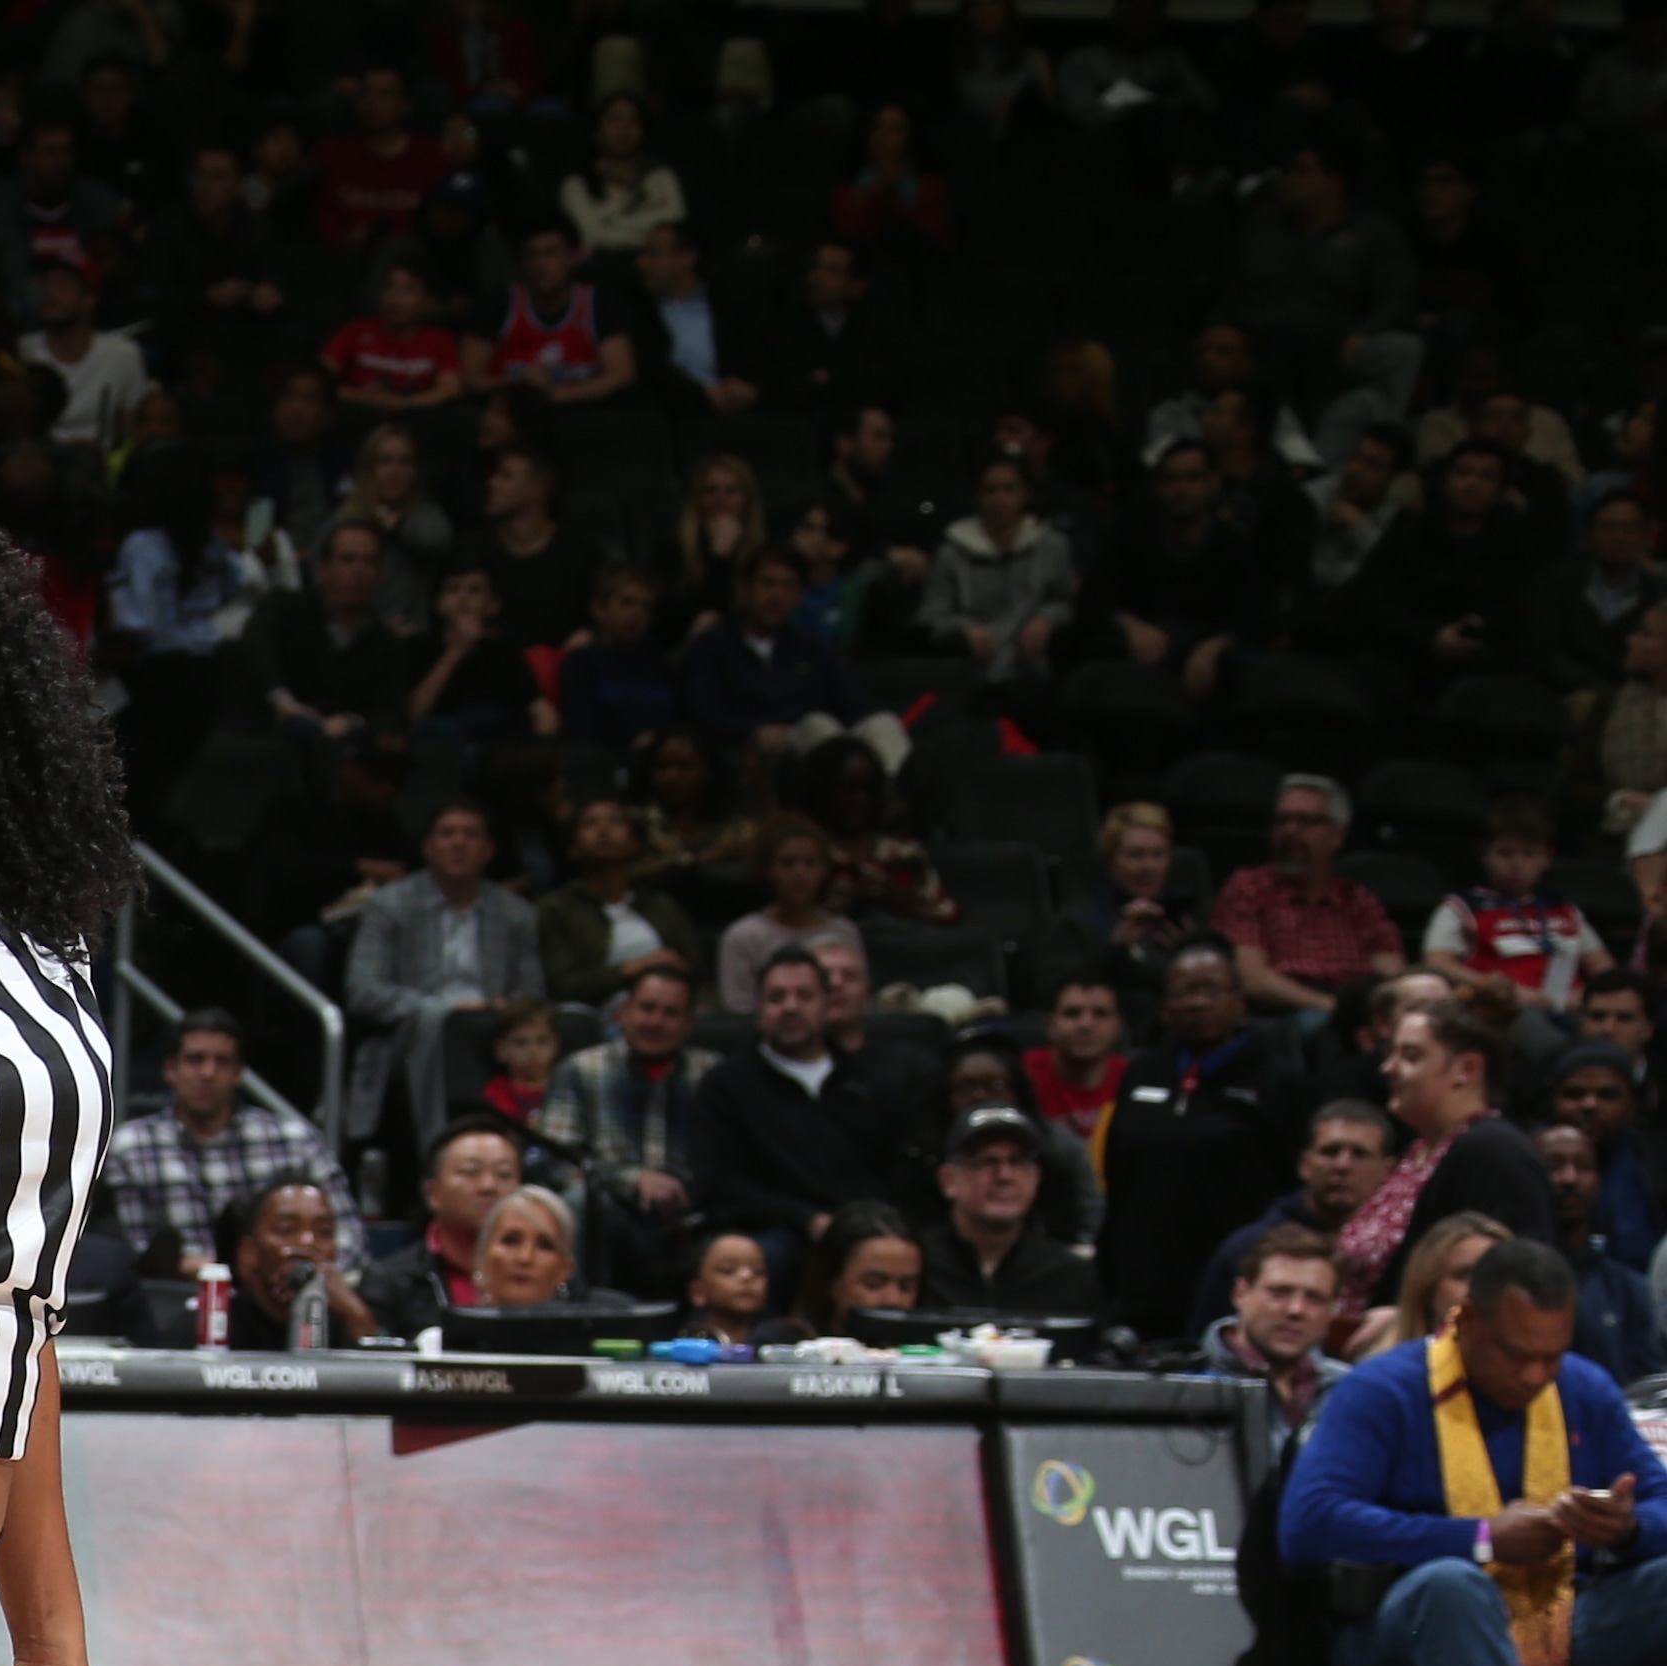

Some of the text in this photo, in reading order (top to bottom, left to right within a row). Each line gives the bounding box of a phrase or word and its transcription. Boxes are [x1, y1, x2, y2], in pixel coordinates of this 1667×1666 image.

[201, 1365, 318, 1390] WGL.COM
[399, 1370, 513, 1393] #ASKWGL
[593, 1372, 710, 1395] WGL.COM
[1093, 1506, 1238, 1562] WGL
